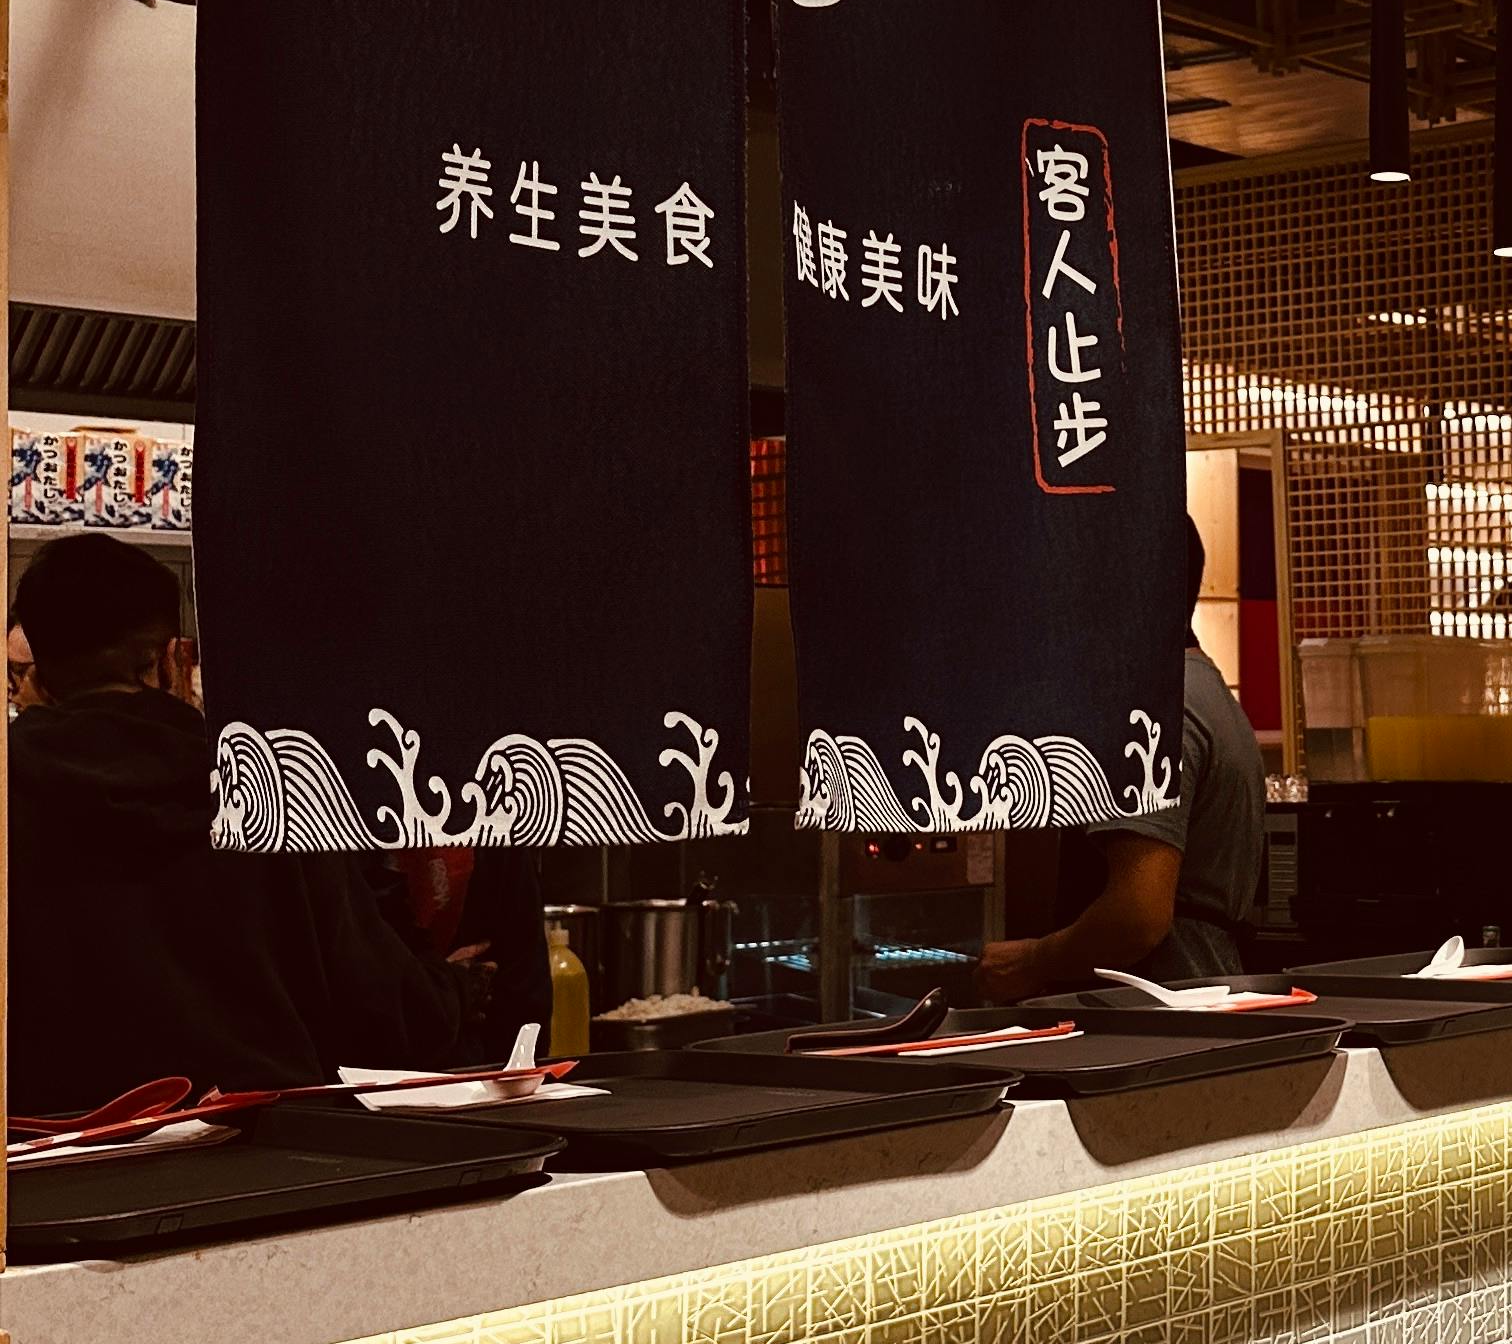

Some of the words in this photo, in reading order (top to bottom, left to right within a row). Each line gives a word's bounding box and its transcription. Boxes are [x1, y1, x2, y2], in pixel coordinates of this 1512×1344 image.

[436, 143, 715, 268] 养生美食
[793, 200, 959, 320] 健康美味
[1025, 144, 1108, 468] 客人止步
